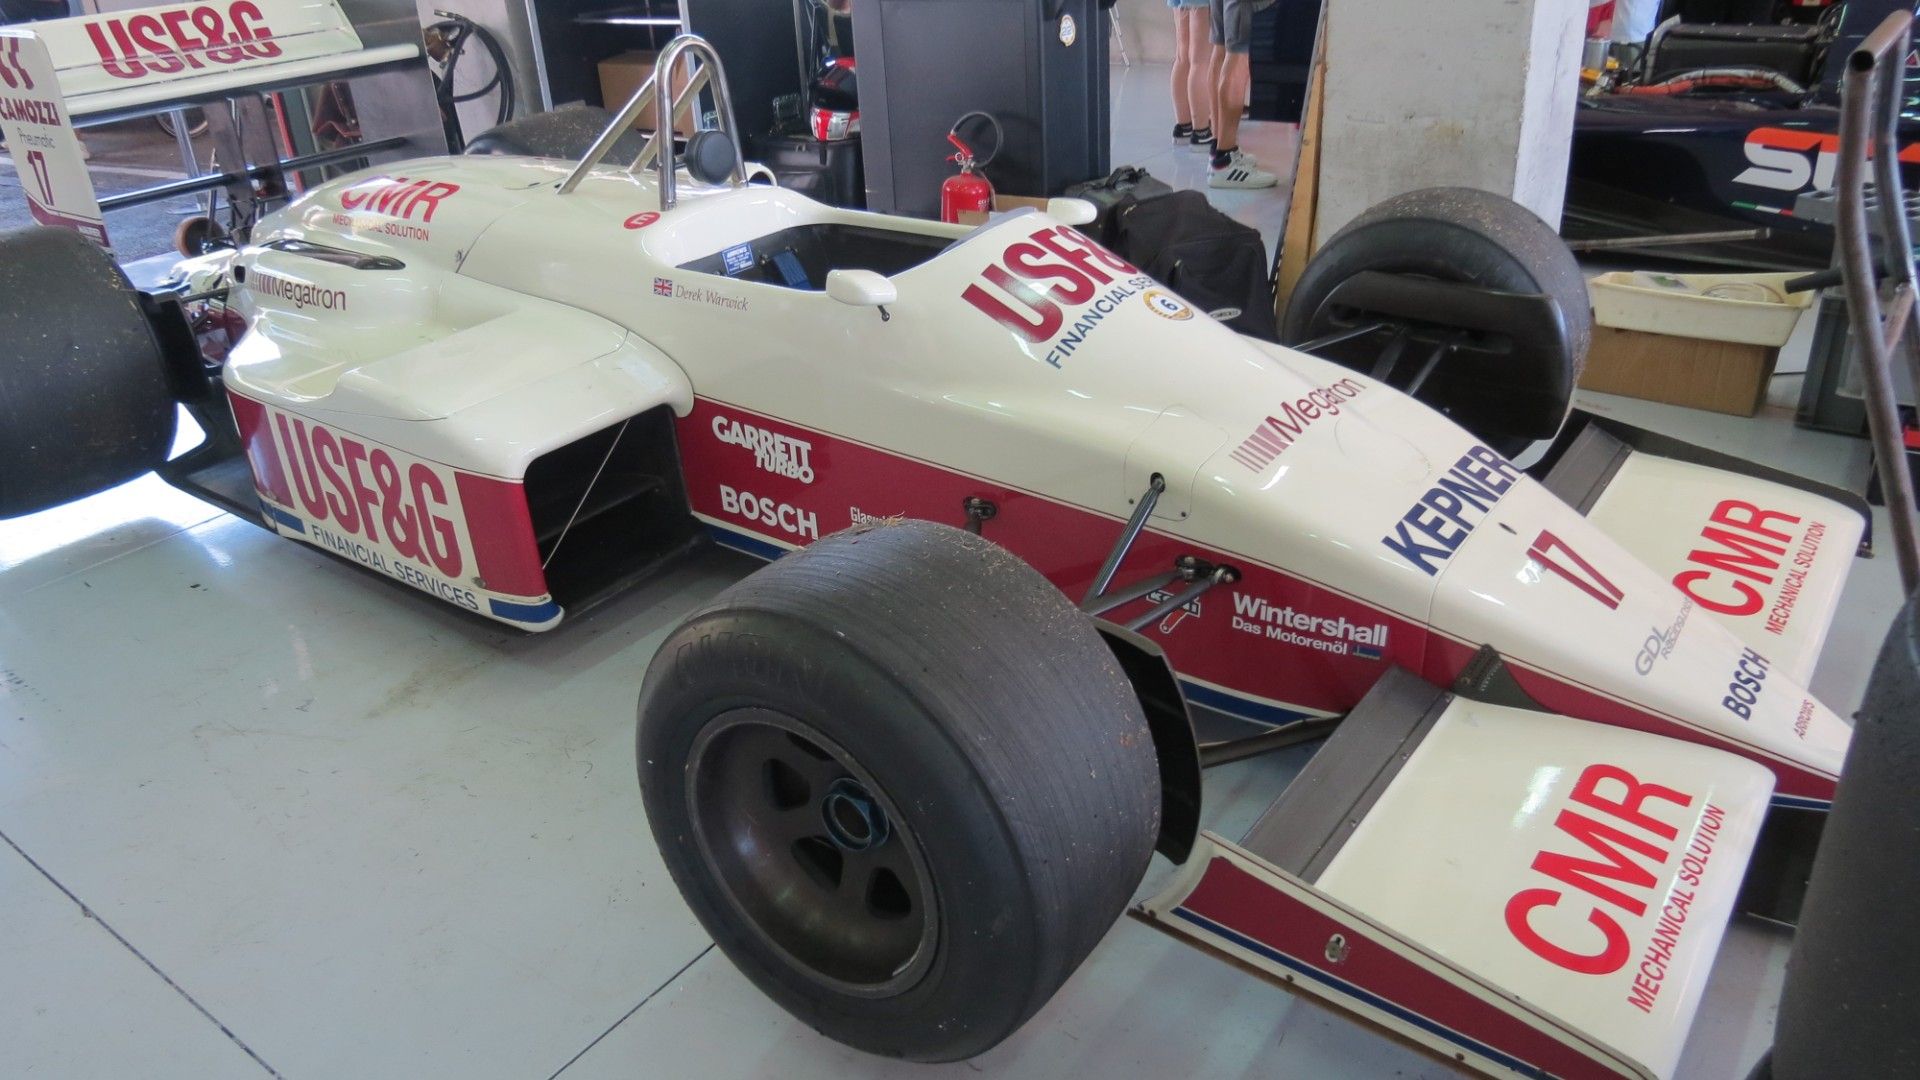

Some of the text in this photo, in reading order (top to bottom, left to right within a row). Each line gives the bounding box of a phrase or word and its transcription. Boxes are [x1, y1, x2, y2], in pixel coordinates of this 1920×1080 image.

[85, 1, 283, 79] USF&G
[0, 97, 61, 126] CAMOZZI
[27, 150, 54, 206] 17
[341, 176, 460, 222] CMR
[384, 223, 429, 241] SOLUTION
[271, 278, 346, 311] Megatron
[675, 284, 749, 311] Derek Warwick
[1046, 285, 1136, 369] FINANCIAL
[712, 416, 812, 468] GARRETT
[754, 450, 814, 484] TURBO
[275, 412, 463, 578] USF&G
[720, 485, 819, 540] BOSCH
[1381, 445, 1523, 576] KEPNER
[311, 524, 479, 610] FINANCIAL SERVICES
[1526, 529, 1624, 610] 17
[1672, 499, 1801, 616] CMR
[1765, 521, 1826, 635] MECHANICAL SOLUTION
[1232, 592, 1387, 647] Wintershall
[1232, 616, 1347, 655] Das Motorenöl
[1635, 627, 1670, 675] GDL
[1721, 646, 1770, 721] BOSCH
[1794, 699, 1815, 740] ARROWS
[1505, 764, 1693, 975] CMR
[1627, 804, 1725, 1014] MECHANICAL SOLUTION
